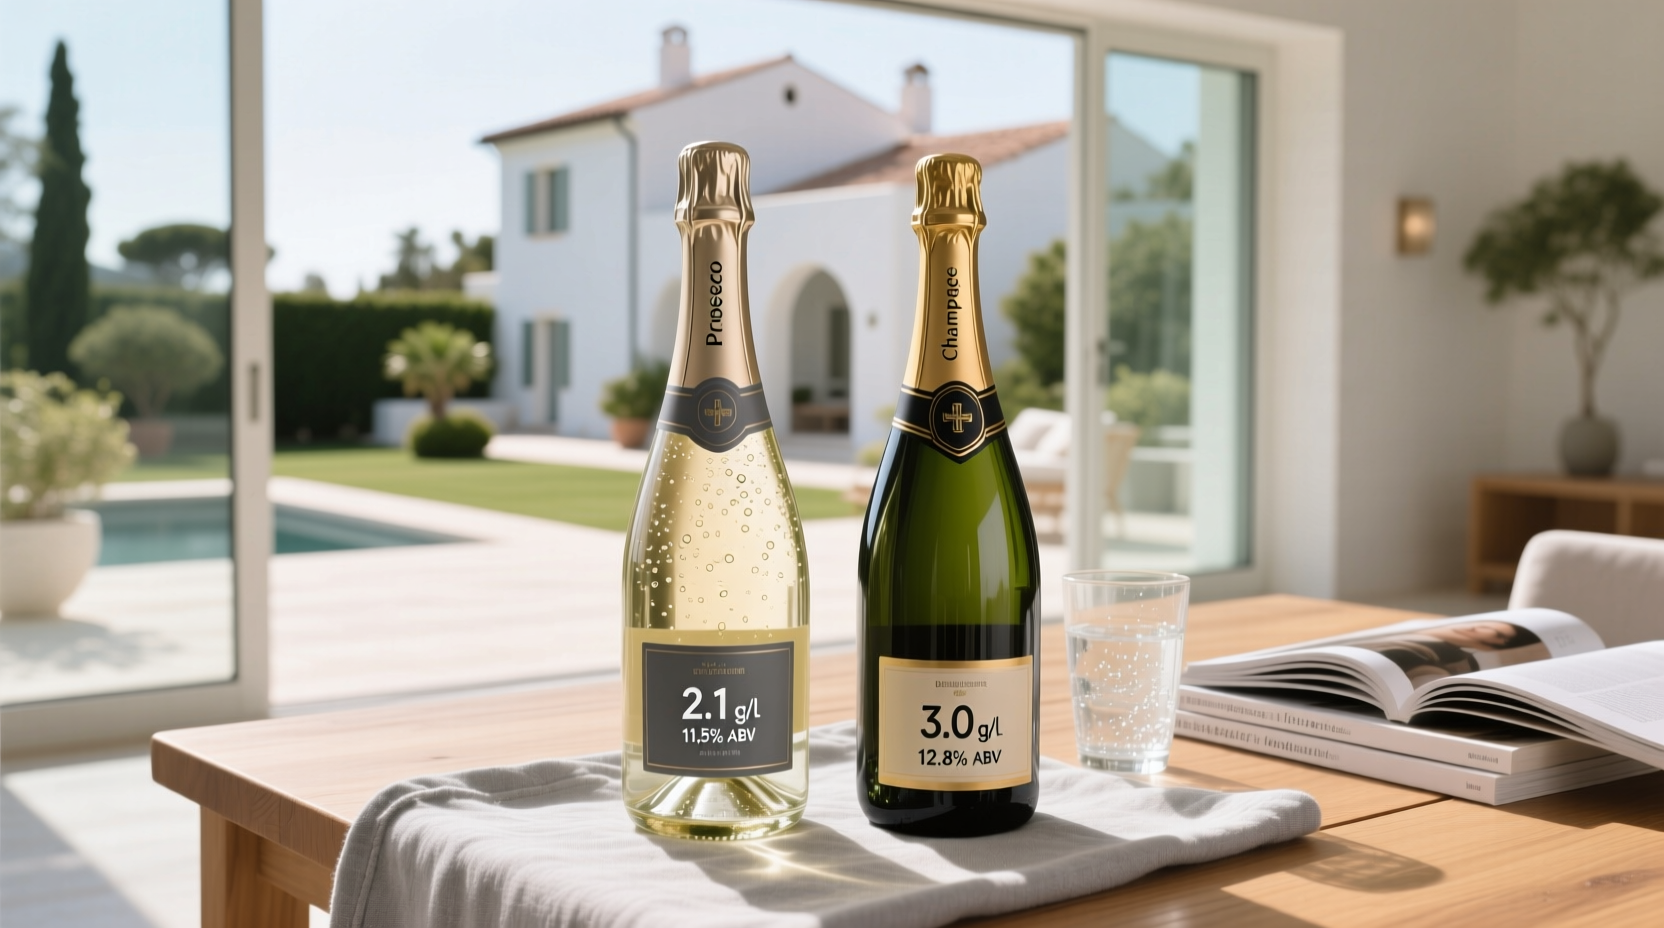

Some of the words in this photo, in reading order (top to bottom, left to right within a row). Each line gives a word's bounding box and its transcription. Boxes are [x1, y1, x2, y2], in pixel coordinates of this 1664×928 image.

[682, 686, 726, 720] 2.1
[727, 727, 756, 743] ABV
[920, 705, 974, 739] 3.0
[918, 748, 968, 767] 12.8%
[972, 749, 1002, 766] ABV
